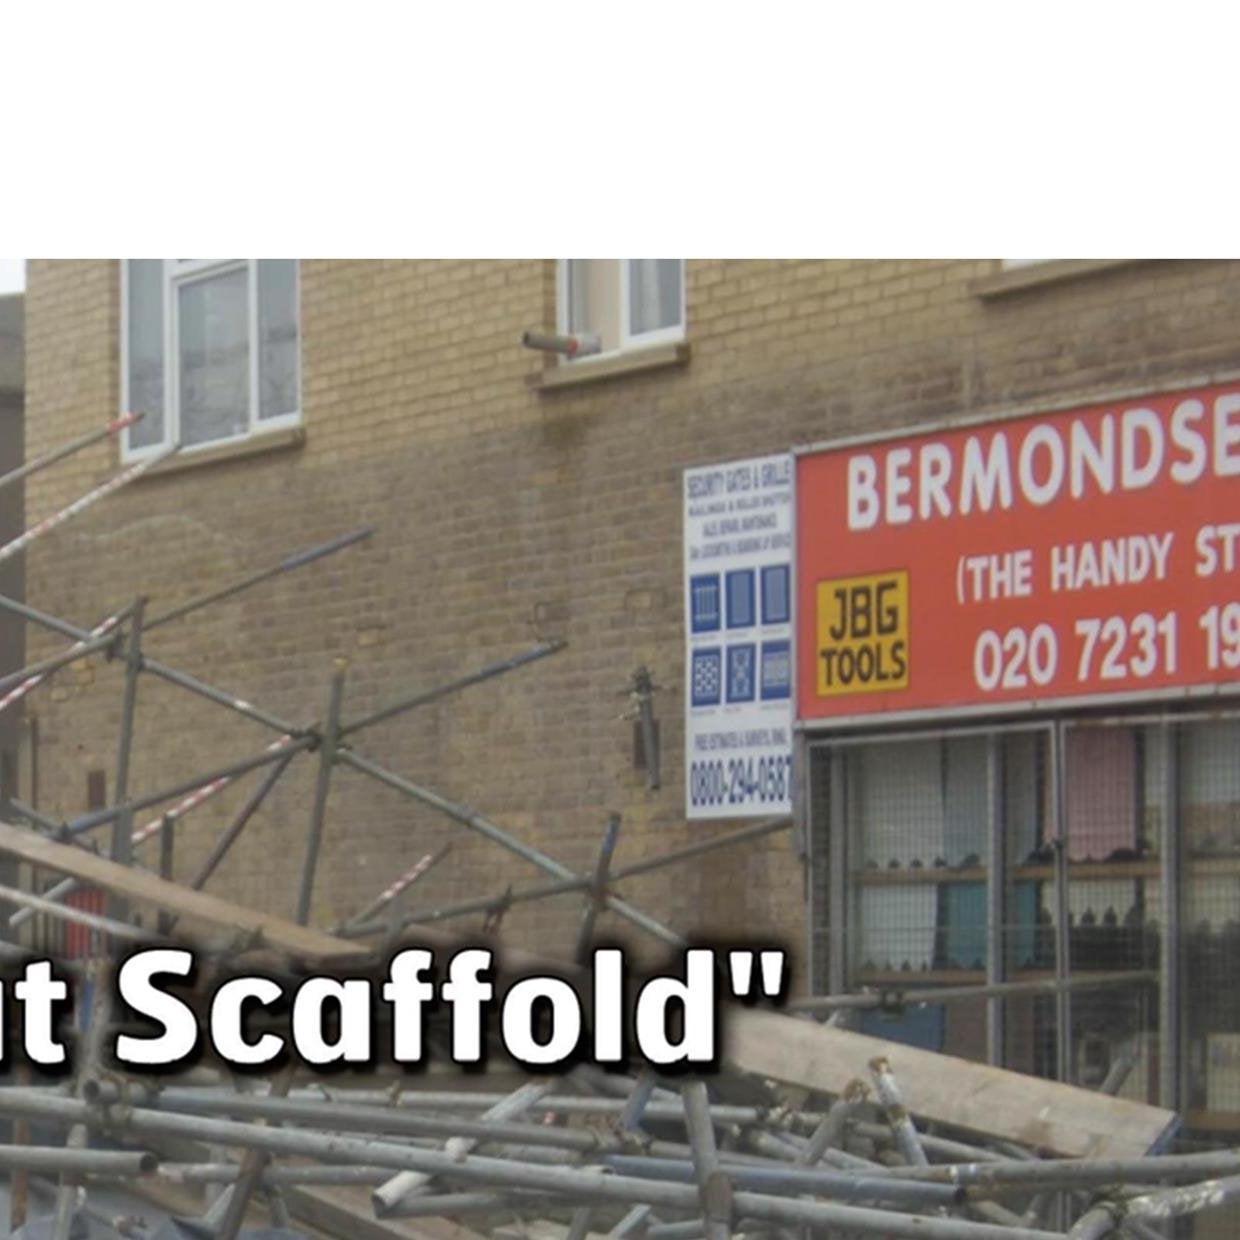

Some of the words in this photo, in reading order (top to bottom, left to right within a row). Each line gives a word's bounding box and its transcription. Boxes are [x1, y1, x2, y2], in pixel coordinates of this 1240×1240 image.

[847, 393, 1240, 531] BERMONDSE
[956, 549, 1033, 604] (THE
[1050, 531, 1175, 592] HANDY
[1195, 523, 1240, 578] ST
[829, 580, 899, 642] JBG
[973, 622, 1058, 691] 020
[1074, 611, 1177, 682] 7231
[1198, 601, 1240, 670] 19
[820, 640, 907, 688] TOOLS
